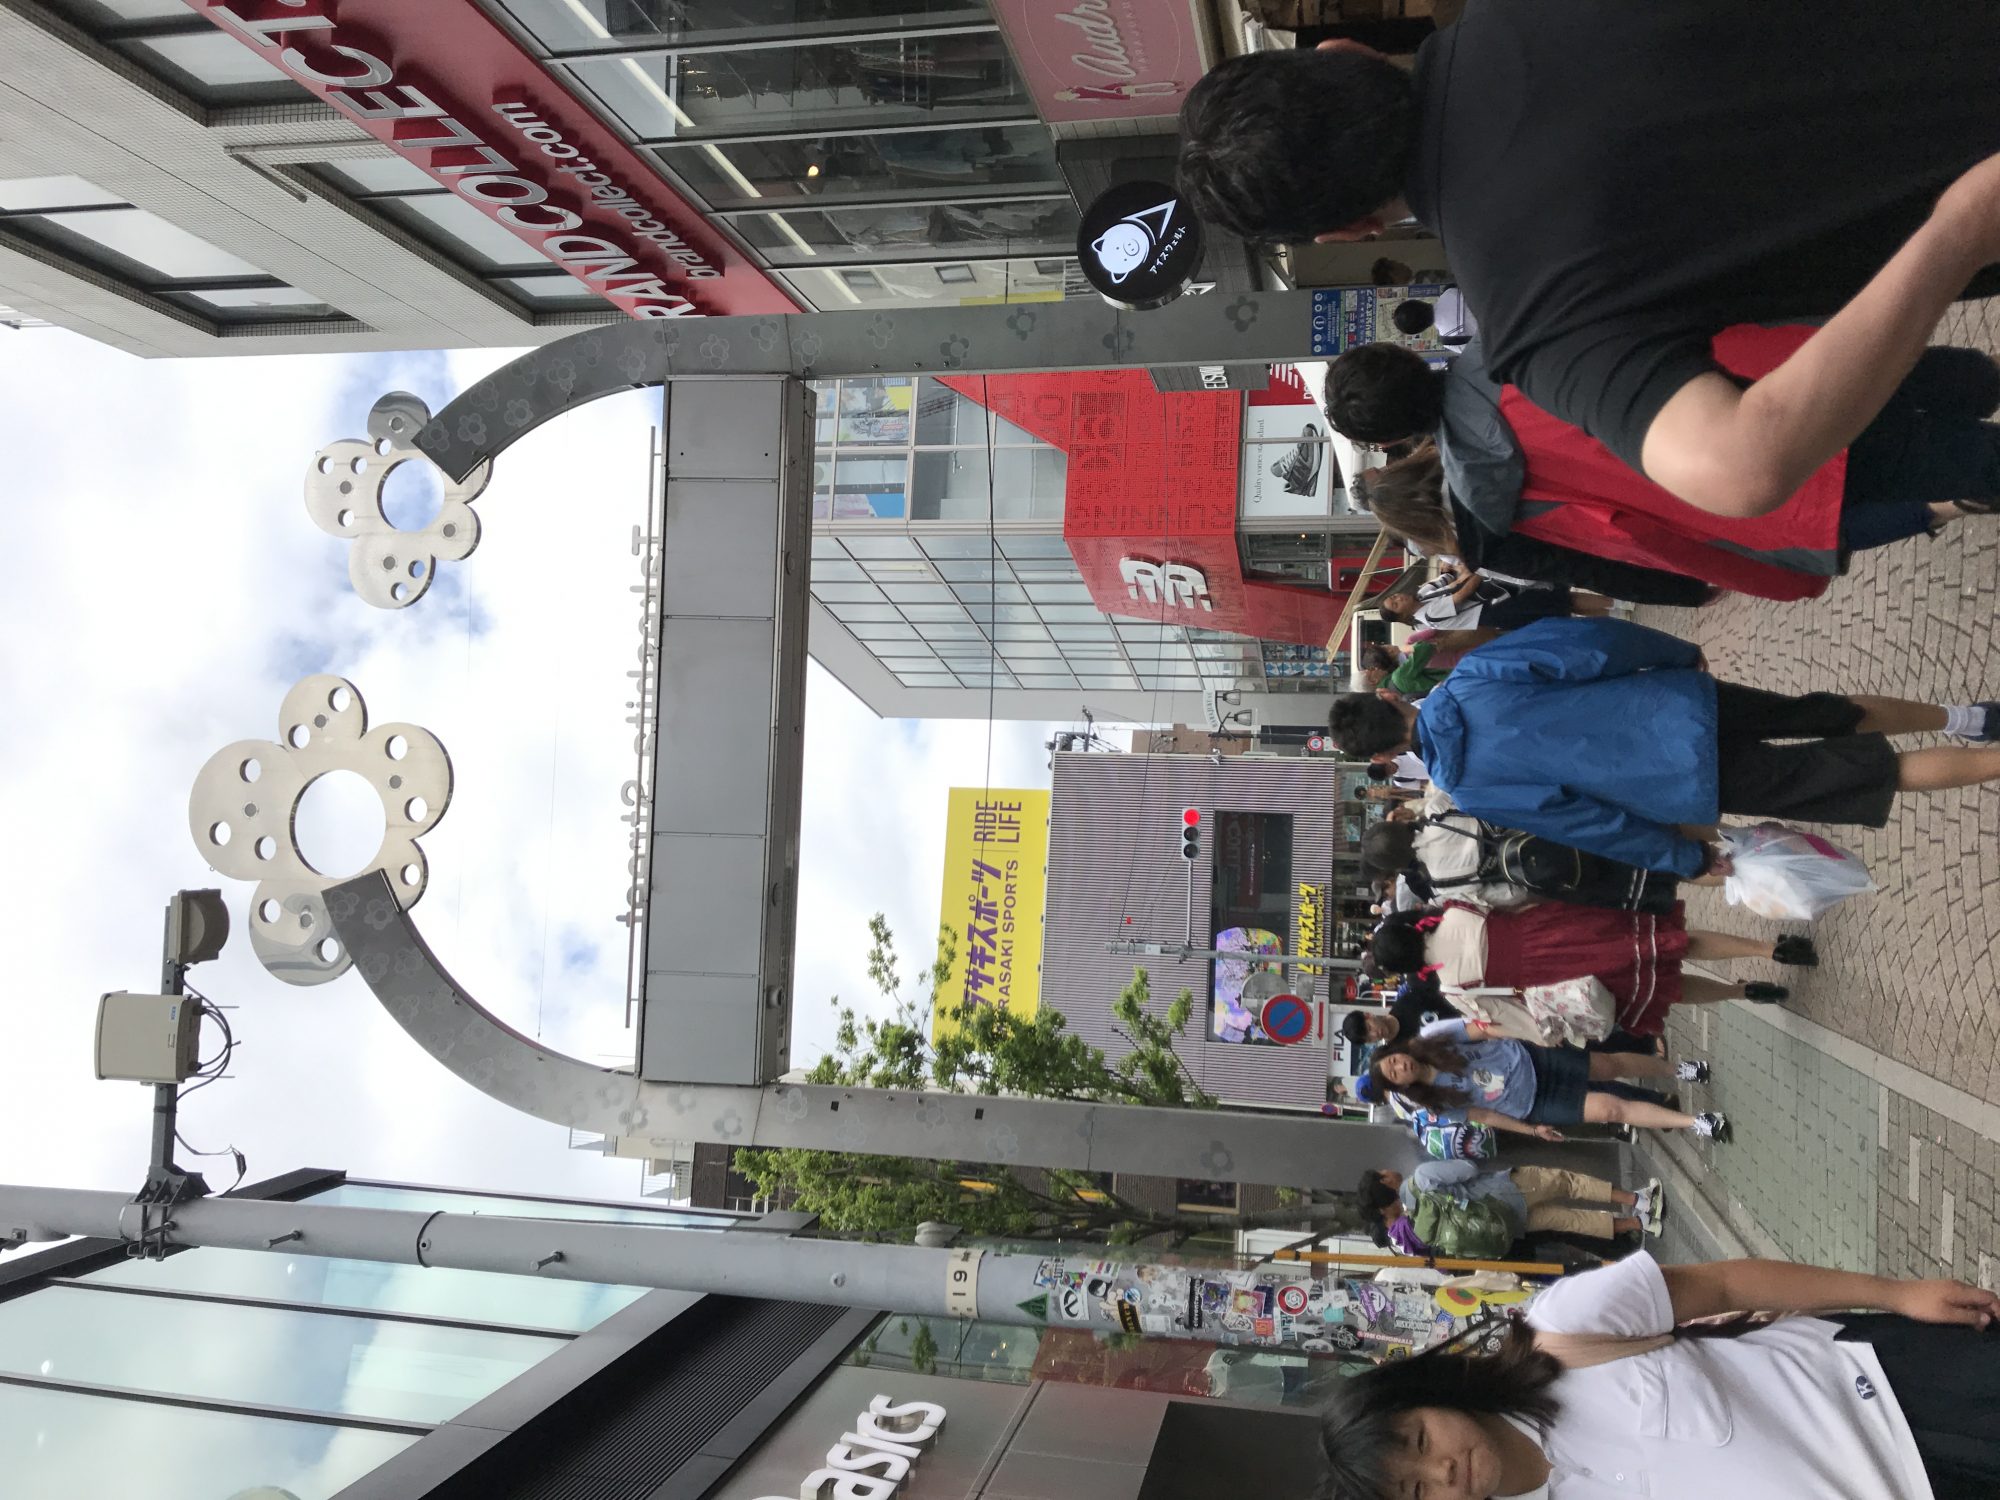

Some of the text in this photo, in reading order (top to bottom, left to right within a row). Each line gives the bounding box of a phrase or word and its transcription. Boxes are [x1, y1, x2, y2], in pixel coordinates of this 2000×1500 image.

[491, 103, 721, 279] brandcollect.com
[543, 235, 706, 319] RAND
[1149, 226, 1186, 274] アイスウェルト
[1365, 289, 1373, 344] 下通り公式マップ
[1199, 365, 1229, 389] EISW
[1252, 477, 1263, 504] Quality
[973, 800, 998, 842] RIDE
[998, 801, 1022, 843] LIFE
[963, 858, 1002, 1007] ラサキスポーツ
[998, 860, 1018, 1008] RASAKI SPORTS
[1315, 883, 1325, 975] MRASAKI SPORTS
[1333, 1029, 1344, 1062] FILA
[800, 1394, 947, 1500] asics
